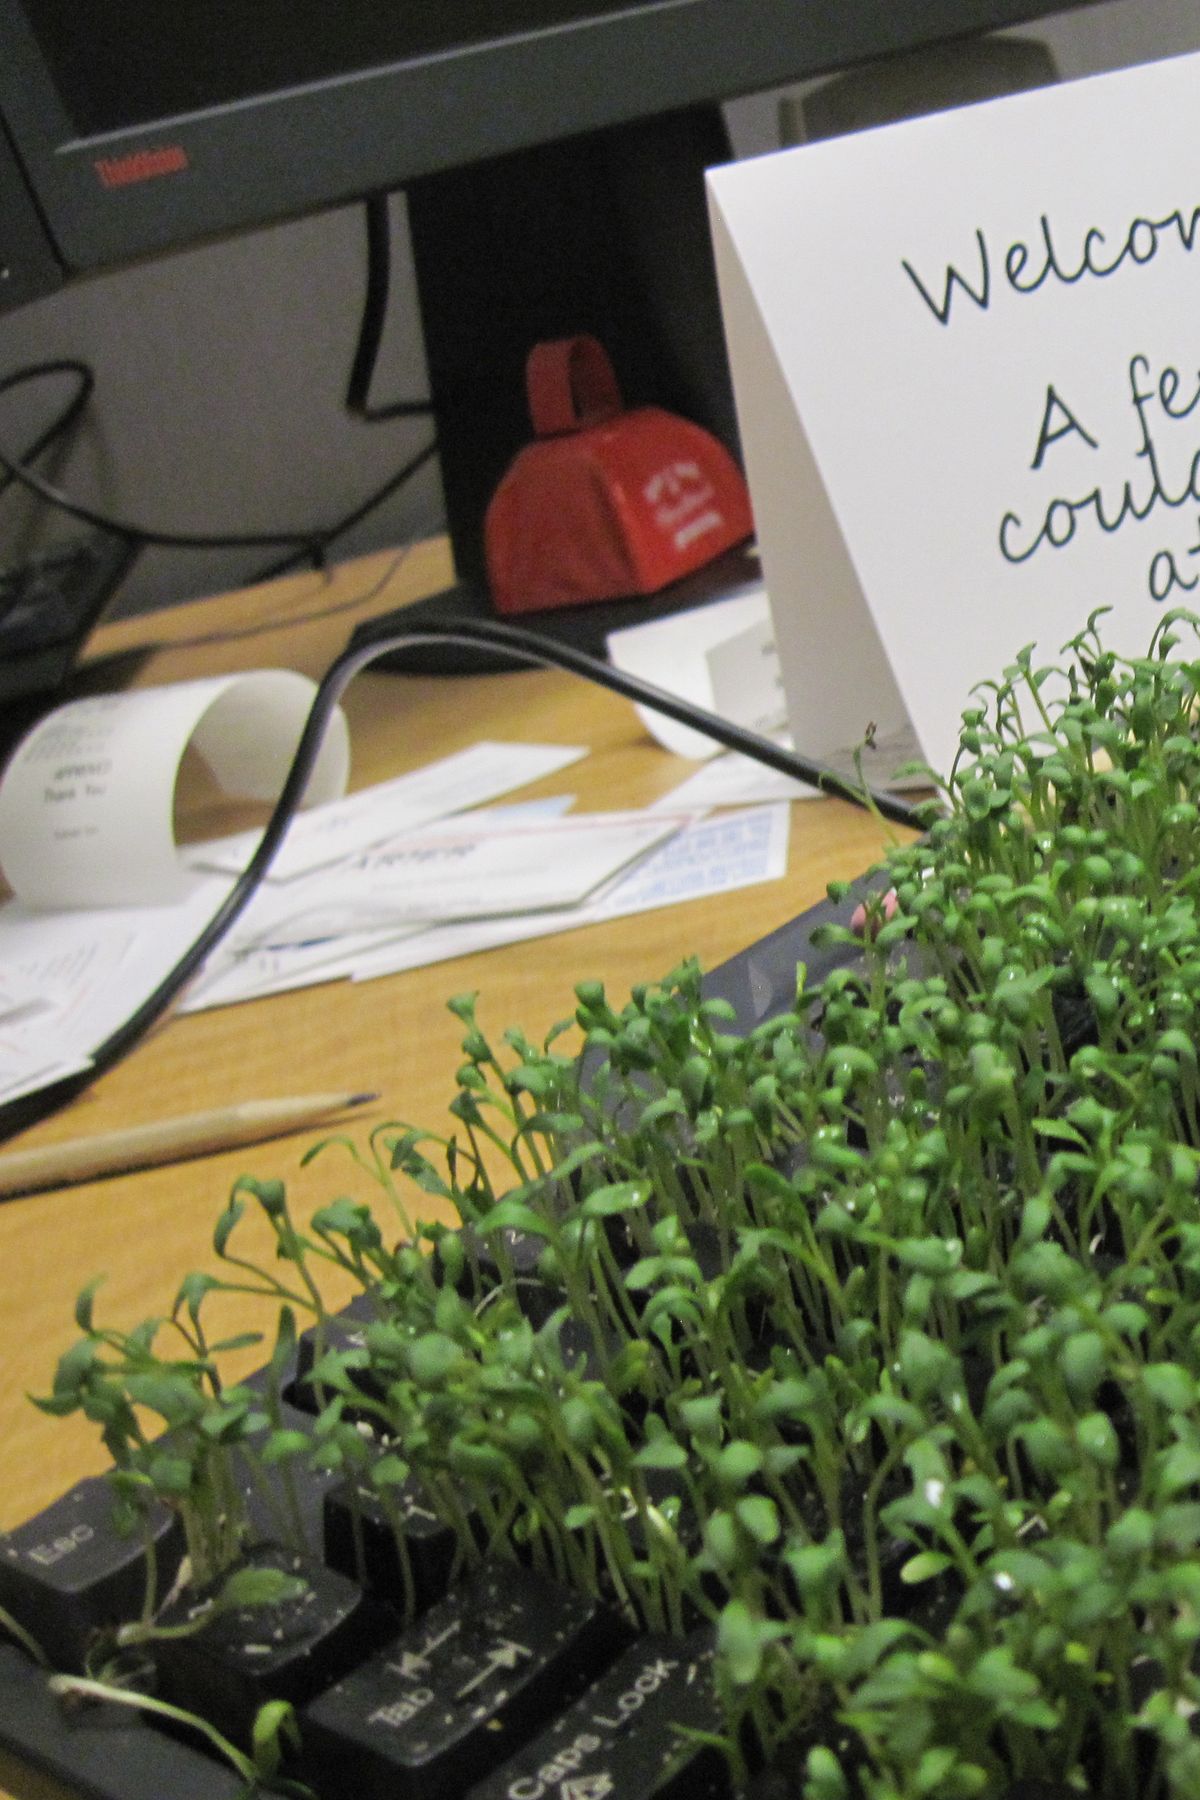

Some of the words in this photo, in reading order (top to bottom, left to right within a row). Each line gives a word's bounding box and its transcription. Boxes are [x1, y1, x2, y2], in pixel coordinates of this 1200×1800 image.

[1031, 384, 1099, 470] A
[28, 1523, 95, 1566] Esc
[367, 1687, 435, 1728] Tab
[507, 1733, 601, 1800] Caps
[592, 1657, 679, 1728] Lock
